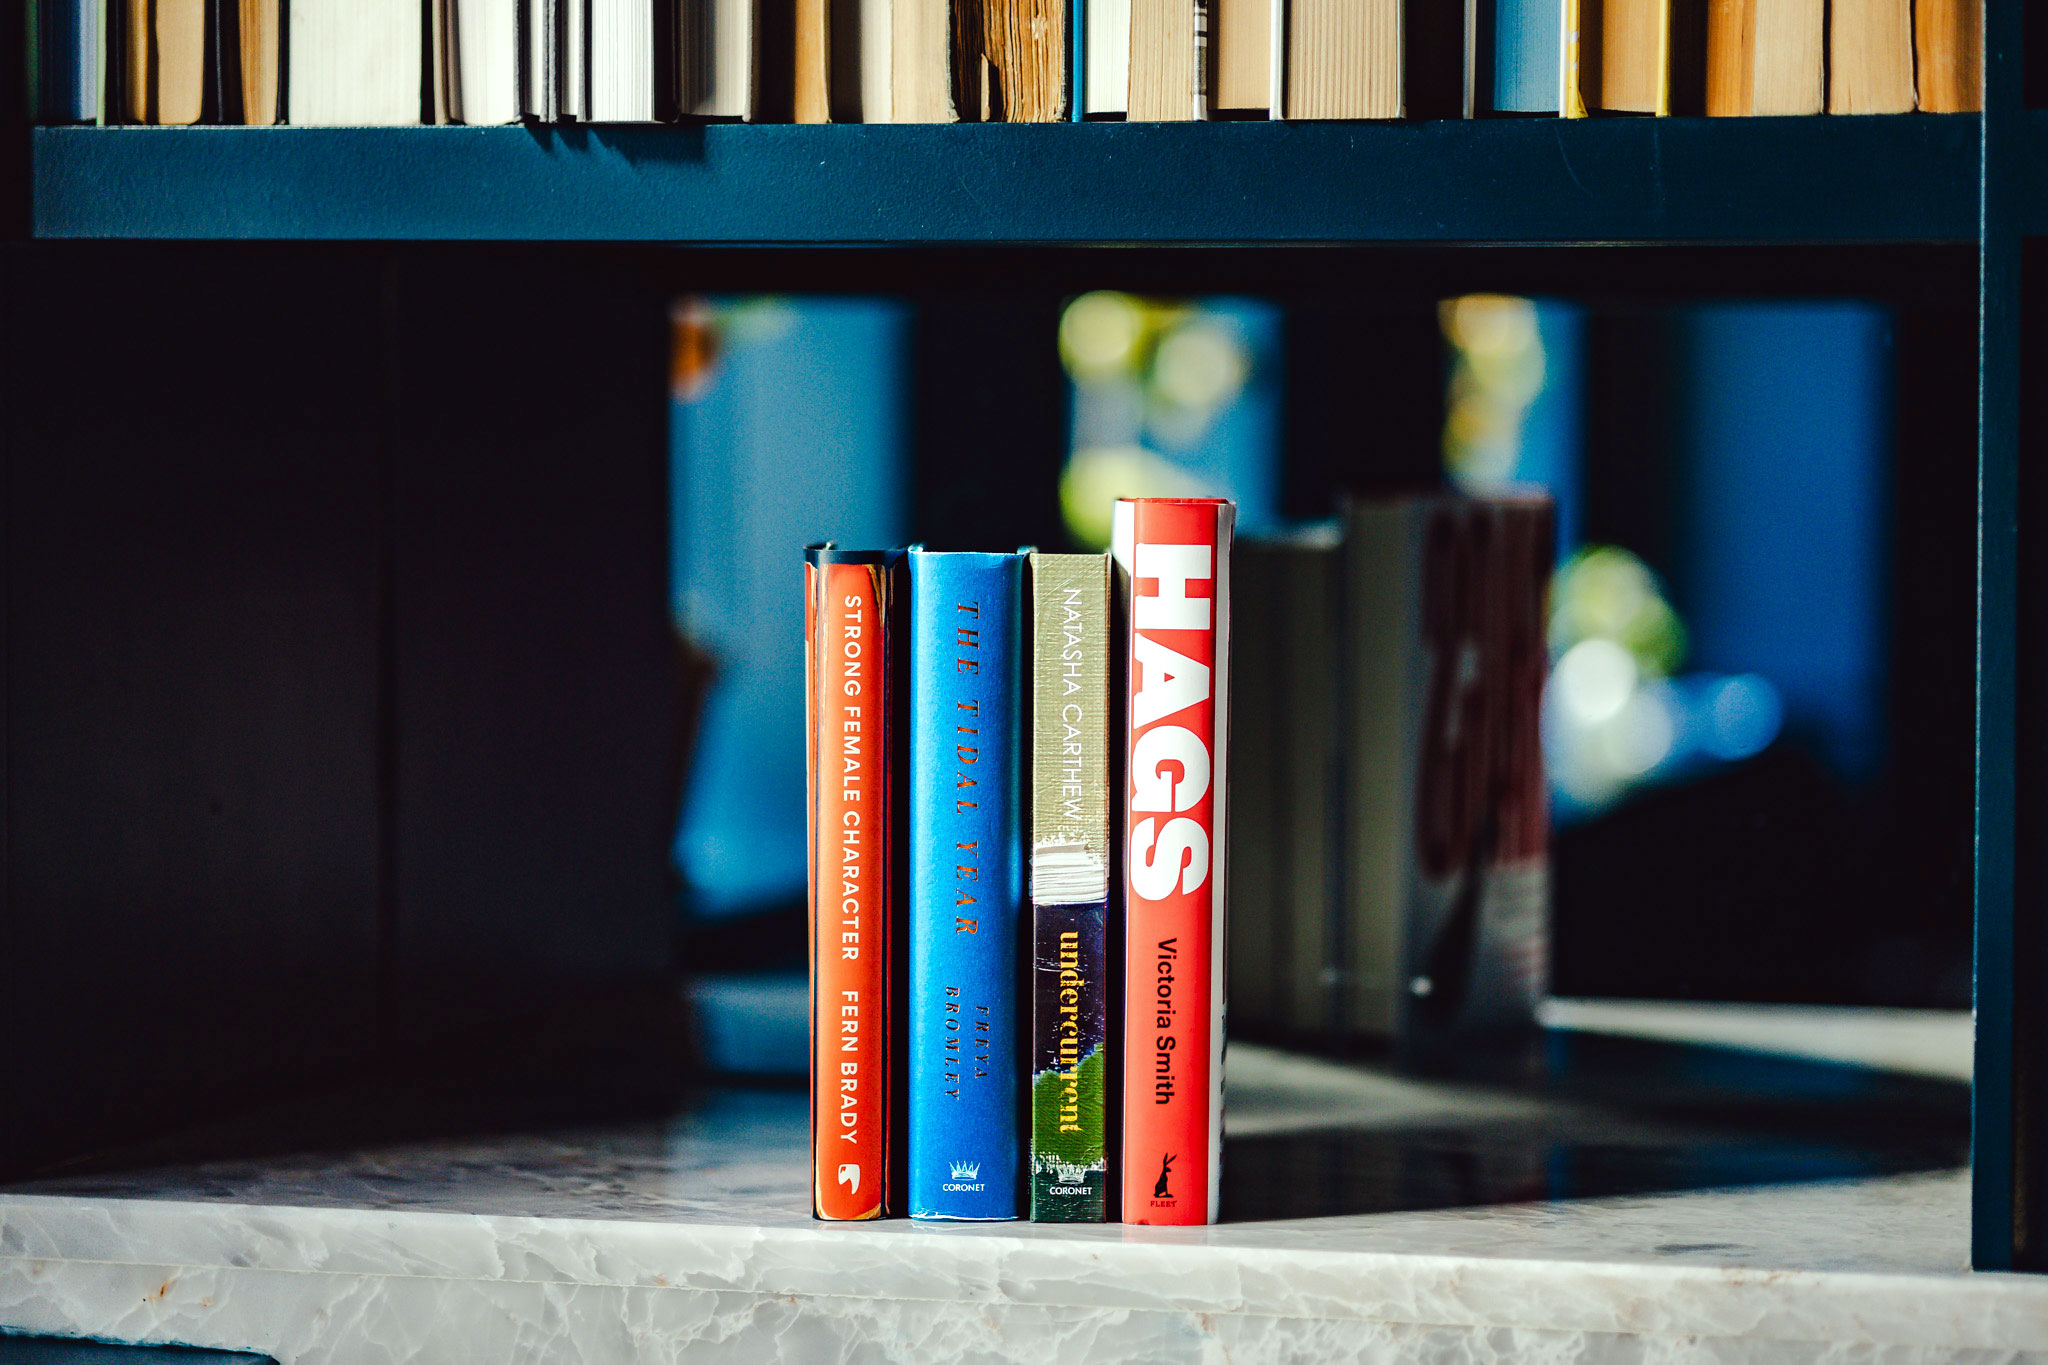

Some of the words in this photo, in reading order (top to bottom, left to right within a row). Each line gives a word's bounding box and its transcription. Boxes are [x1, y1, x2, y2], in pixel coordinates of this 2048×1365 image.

[843, 595, 861, 697] STRONG
[957, 601, 980, 675] THE
[1061, 588, 1082, 696] NATASHA
[843, 706, 861, 802] FEMALE
[956, 700, 980, 815] TIDAL
[1062, 703, 1082, 821] CARTHEW
[1130, 543, 1212, 901] HAGS
[842, 810, 861, 960] CHARACTER
[955, 840, 979, 936] YEAR
[841, 990, 859, 1052] FERN
[1156, 937, 1178, 1029] Victoria
[945, 985, 960, 1100] BROMLEY
[974, 1005, 990, 1079] FREYA
[1059, 931, 1085, 1134] undercurrent
[1155, 1035, 1177, 1105] Smith
[840, 1062, 858, 1144] BRADY
[942, 1183, 985, 1192] CORONET
[1049, 1186, 1093, 1195] CORONET
[1150, 1200, 1177, 1208] FLEET
